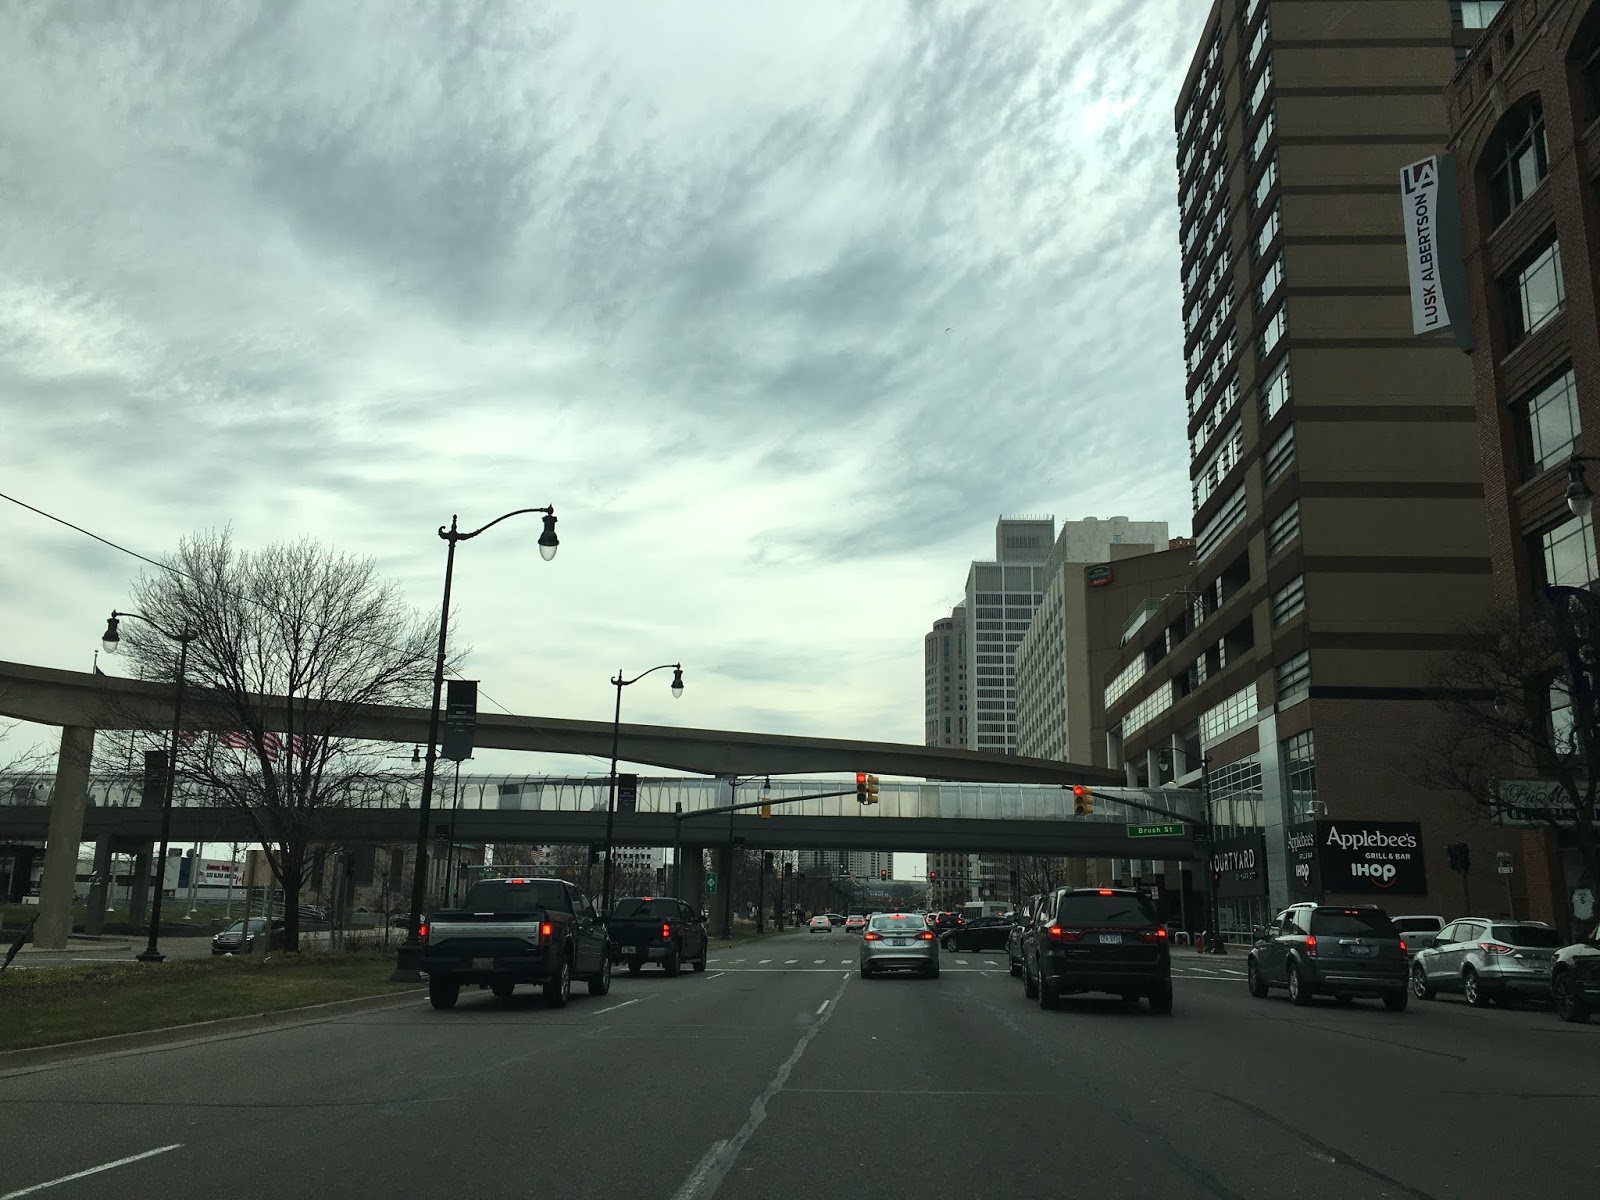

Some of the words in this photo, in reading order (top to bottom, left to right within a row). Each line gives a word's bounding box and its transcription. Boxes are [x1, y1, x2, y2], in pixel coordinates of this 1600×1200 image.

[1414, 192, 1434, 285] ALBERTSON
[1423, 284, 1439, 327] LUSK
[1287, 831, 1314, 853] Applebee's
[1326, 826, 1417, 850] Applebee's
[1365, 852, 1387, 860] GRILL
